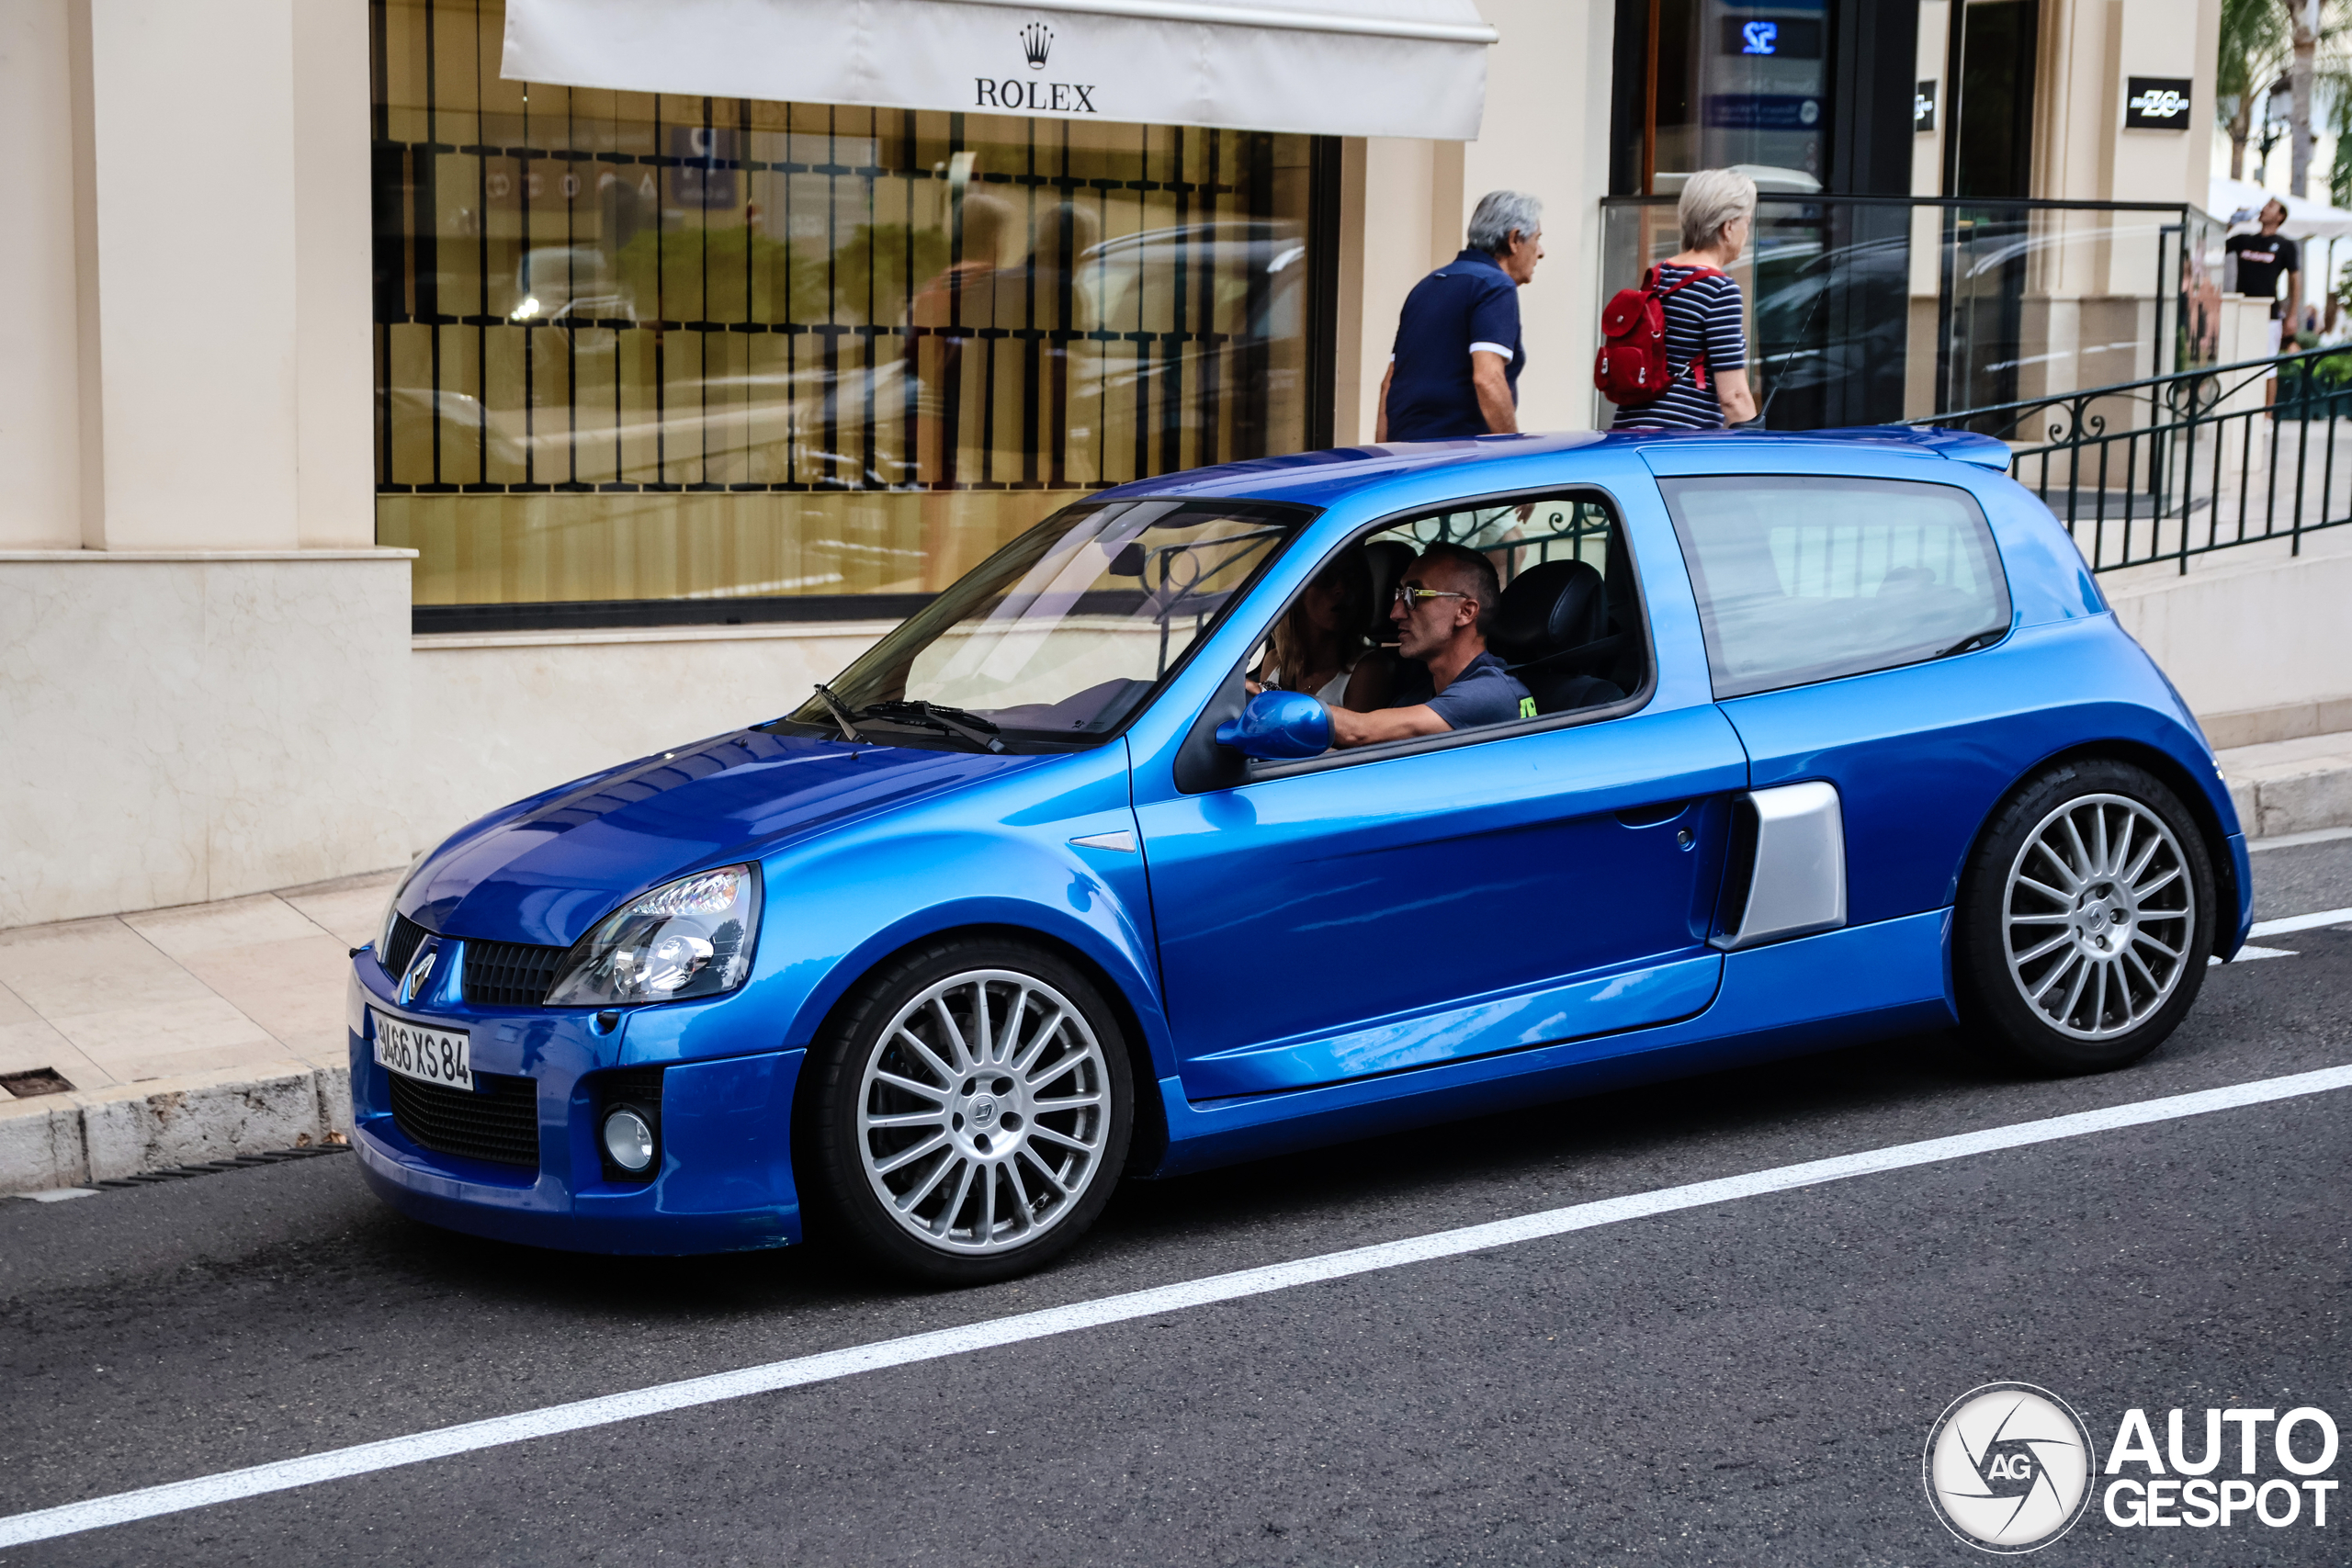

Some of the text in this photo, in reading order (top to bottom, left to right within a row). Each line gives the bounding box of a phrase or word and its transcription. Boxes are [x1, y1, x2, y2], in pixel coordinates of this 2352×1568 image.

[975, 77, 1098, 112] ROLEX
[379, 1019, 468, 1084] 9466 XS 84
